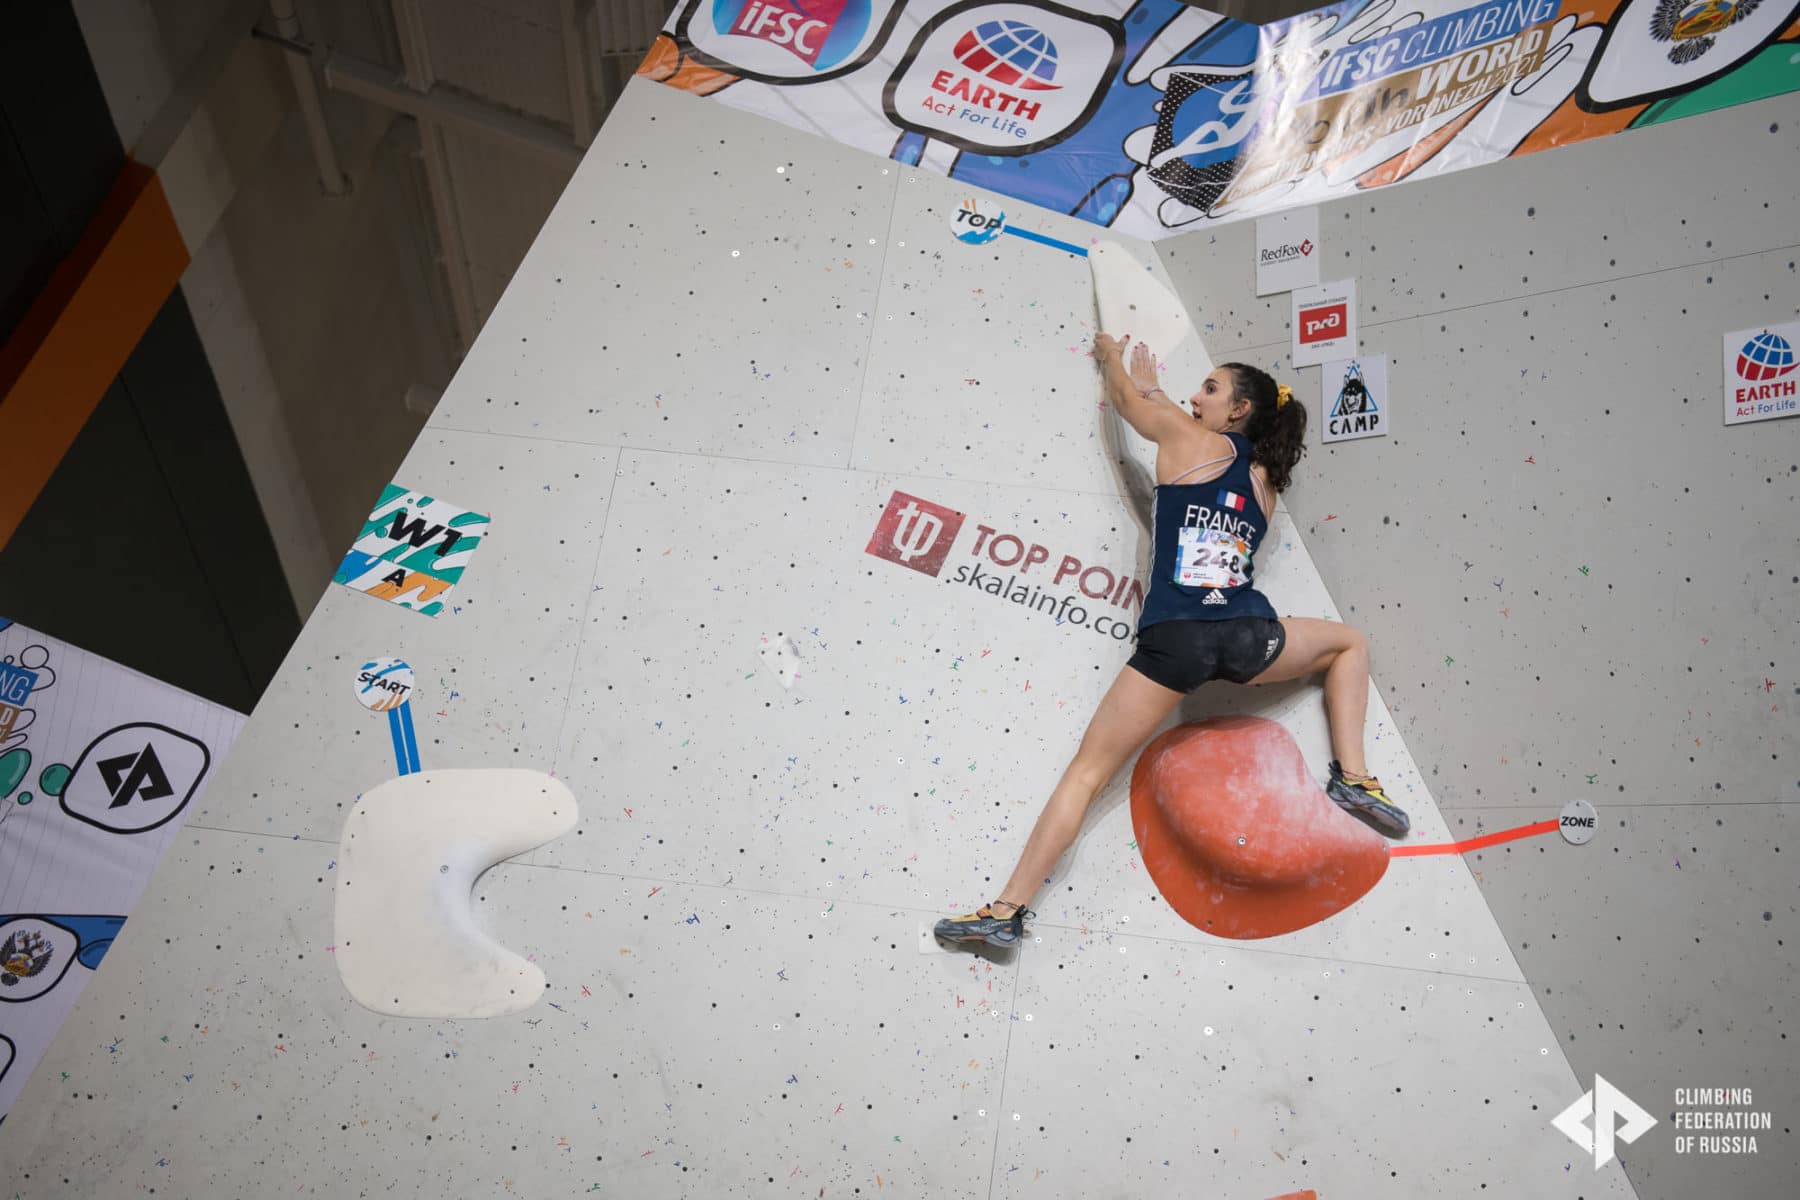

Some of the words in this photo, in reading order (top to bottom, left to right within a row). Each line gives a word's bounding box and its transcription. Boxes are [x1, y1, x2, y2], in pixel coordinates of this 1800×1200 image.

[1320, 38, 1400, 89] IFSC
[1401, 0, 1554, 63] CLIMBING
[1417, 29, 1543, 100] WORLD
[922, 95, 956, 116] Act
[960, 108, 990, 124] For
[991, 116, 1027, 138] Life
[931, 70, 1042, 121] EARTH
[1387, 77, 1491, 133] VORONEZH
[957, 209, 1002, 229] TOP
[1736, 380, 1796, 403] EARTH
[1736, 406, 1755, 416] Act
[1757, 403, 1774, 413] For
[1776, 400, 1796, 411] Life
[1329, 414, 1379, 436] CAMP
[388, 510, 463, 557] W1
[1184, 504, 1256, 548] FRANCE
[382, 568, 408, 588] A
[972, 524, 1049, 573] TOP
[1053, 555, 1144, 613] POIN
[1192, 548, 1240, 574] 248
[953, 563, 1137, 645] skalainfo.co
[357, 671, 410, 696] START
[1561, 815, 1595, 828] ZONE
